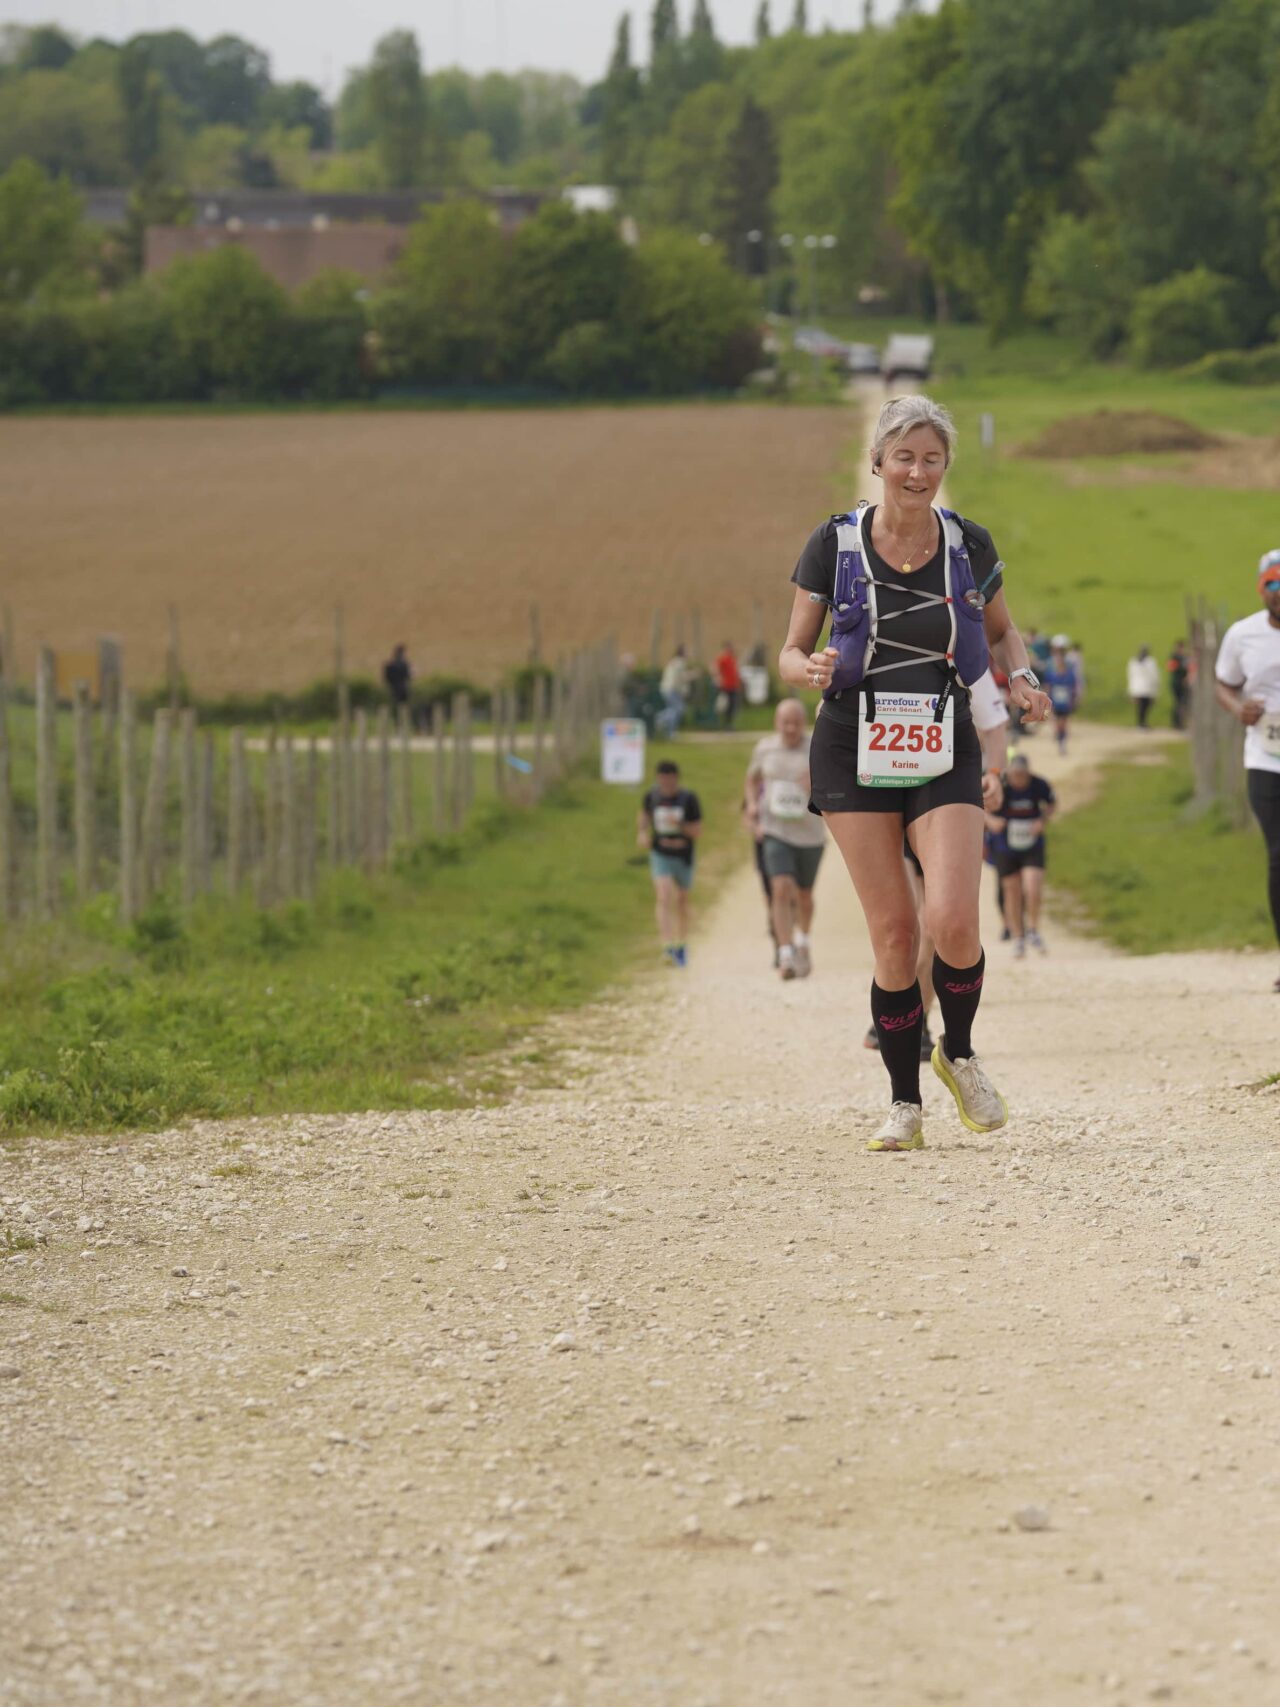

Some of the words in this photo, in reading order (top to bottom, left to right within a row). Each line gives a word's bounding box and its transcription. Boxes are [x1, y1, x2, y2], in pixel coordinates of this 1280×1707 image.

[874, 698, 920, 706] arrefour
[868, 723, 943, 753] 2258
[892, 760, 919, 769] Karine
